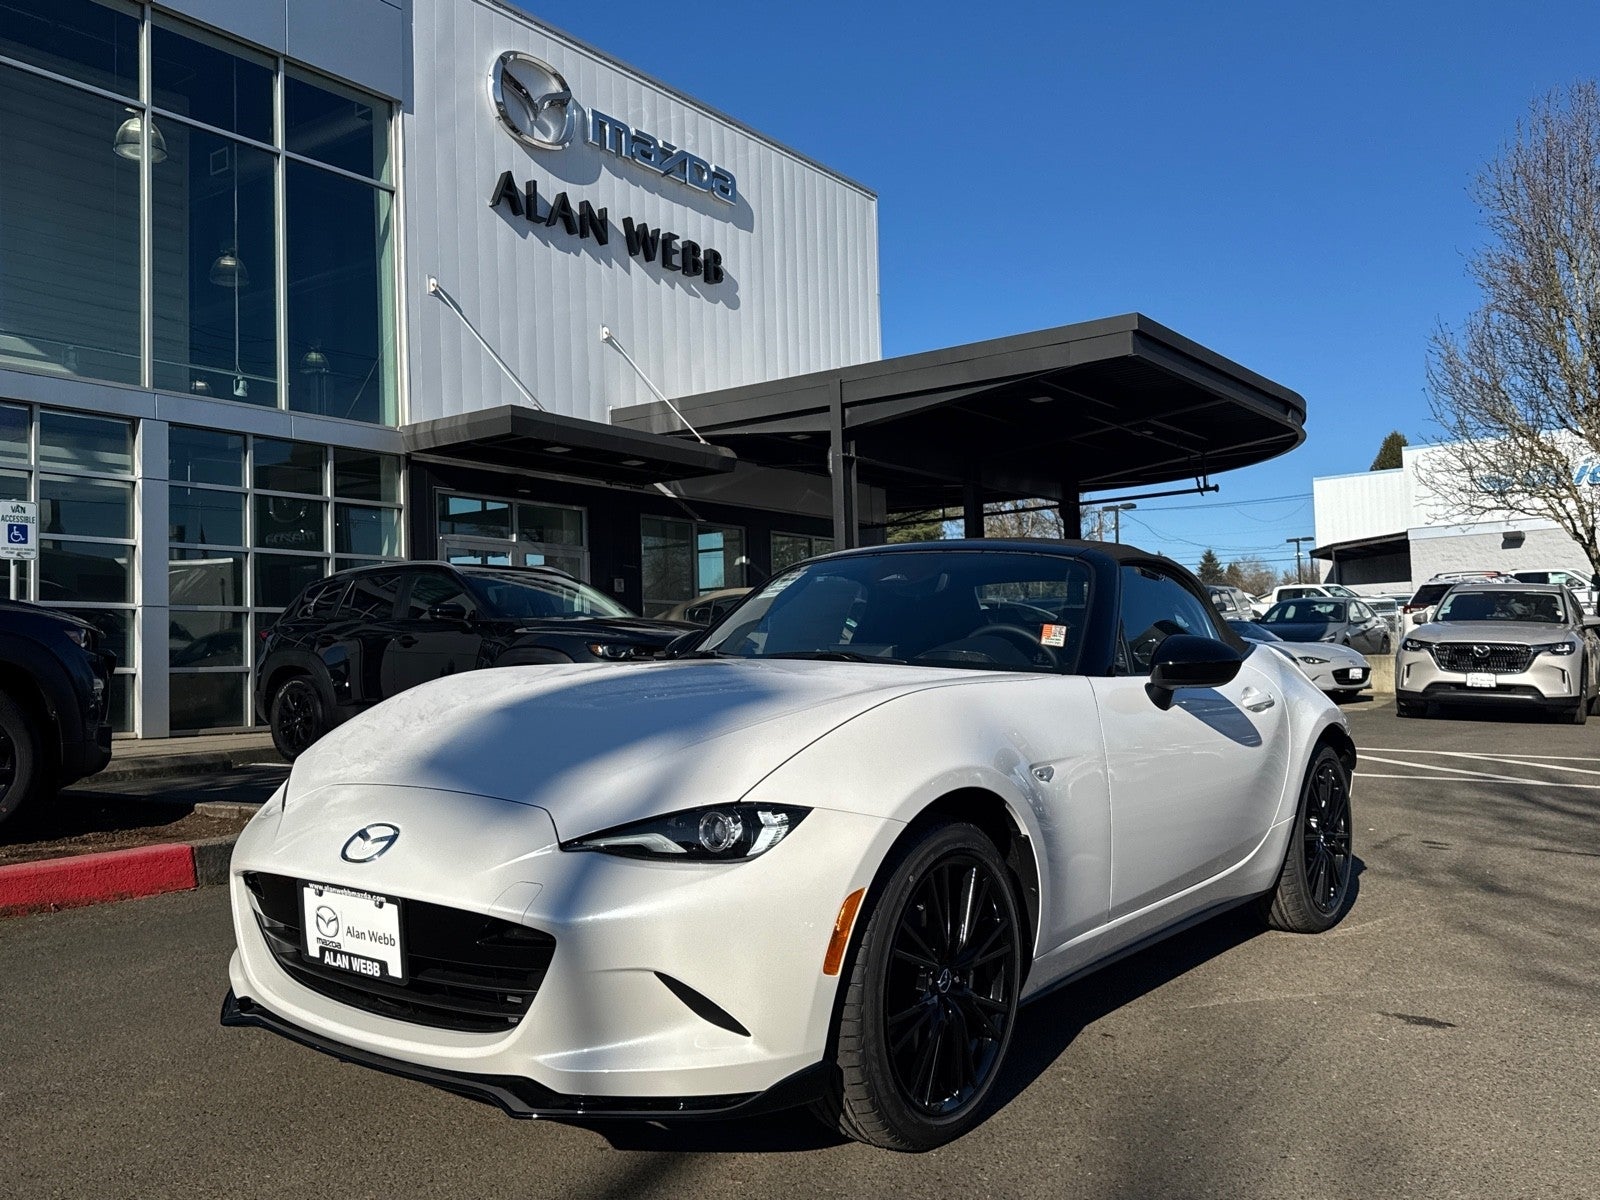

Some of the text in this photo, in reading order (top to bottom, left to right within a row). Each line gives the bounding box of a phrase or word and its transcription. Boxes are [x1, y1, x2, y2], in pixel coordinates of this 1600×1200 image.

[488, 170, 724, 285] ALAN WEBB
[10, 504, 26, 514] VAN
[1, 514, 36, 524] ACCESSIBLE
[316, 937, 342, 950] mazda
[345, 925, 396, 947] Alan Webb
[324, 950, 381, 977] ALAN WEBB
